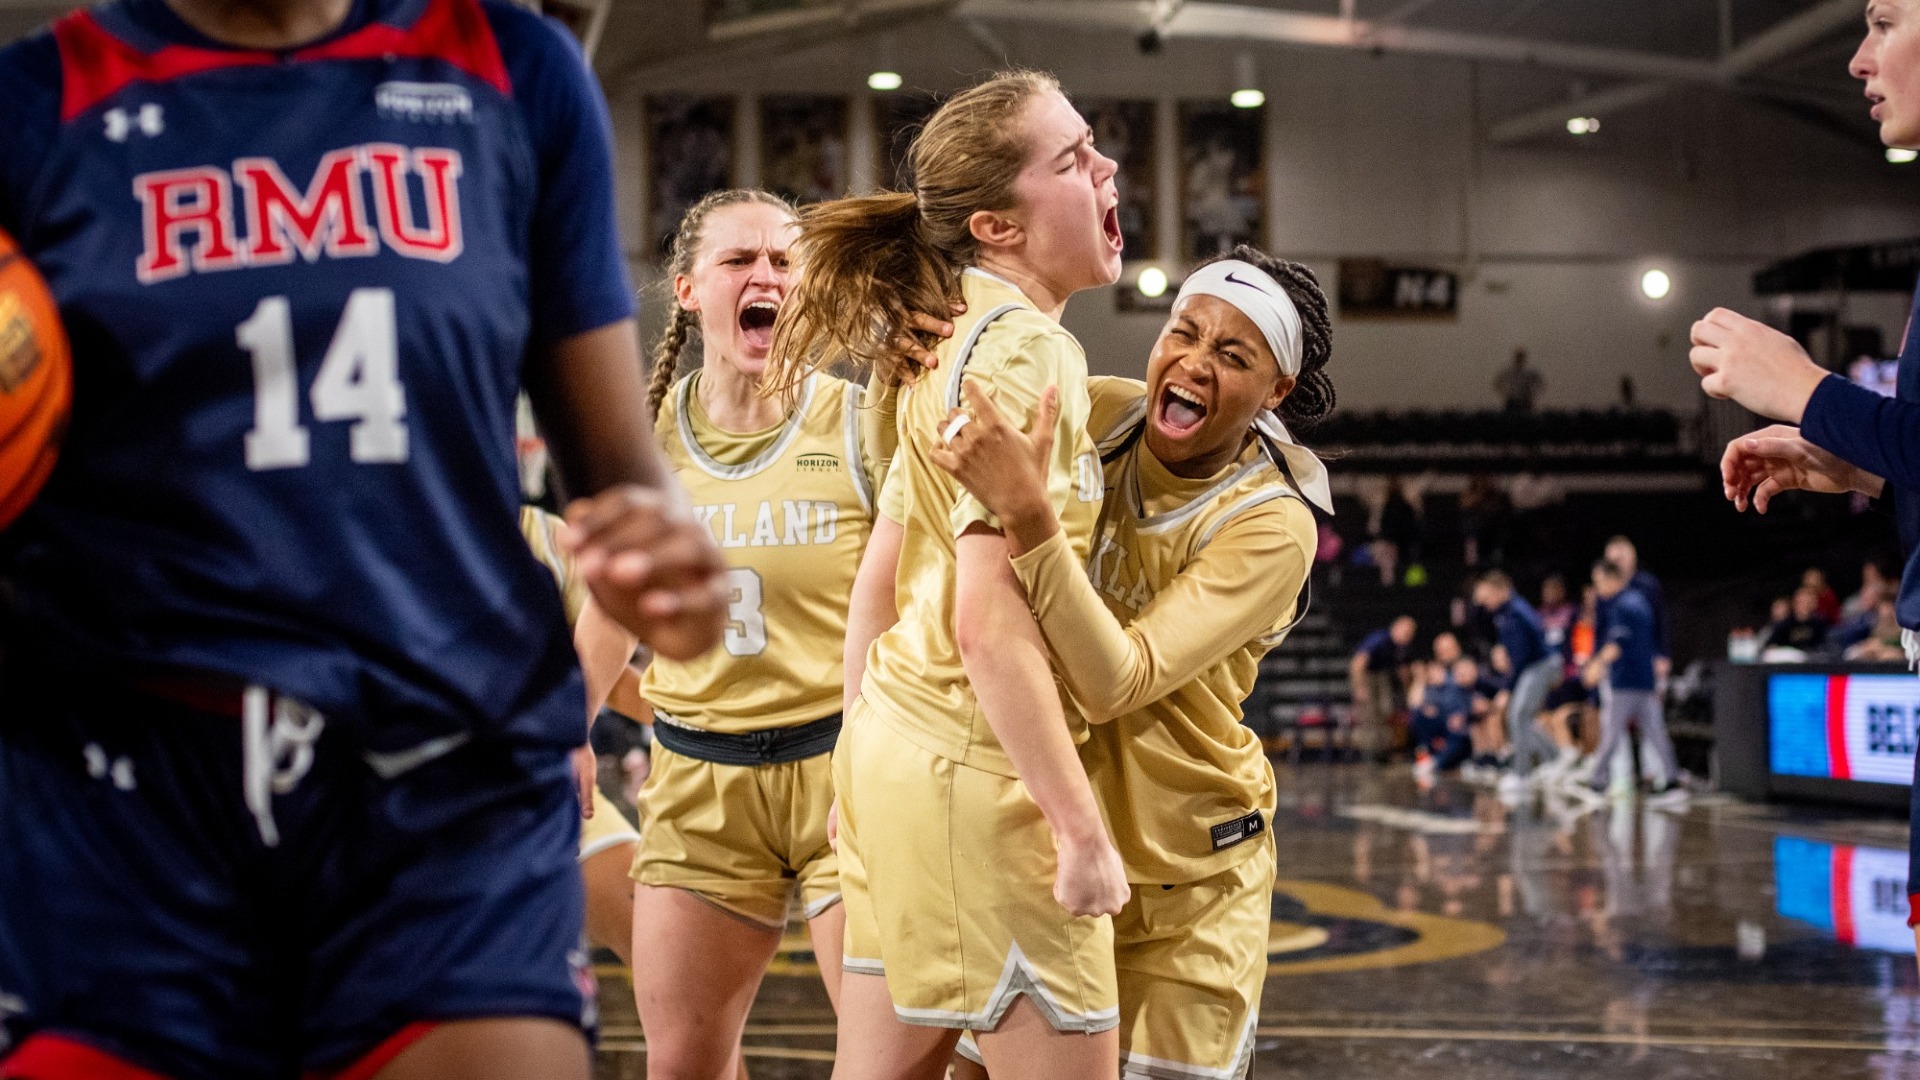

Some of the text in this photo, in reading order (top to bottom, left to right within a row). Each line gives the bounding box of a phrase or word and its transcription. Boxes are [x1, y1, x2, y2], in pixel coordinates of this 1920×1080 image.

[134, 142, 462, 282] RMU
[236, 287, 409, 470] 14
[796, 459, 839, 467] HORIZON
[724, 568, 767, 656] 3
[1249, 820, 1258, 831] M
